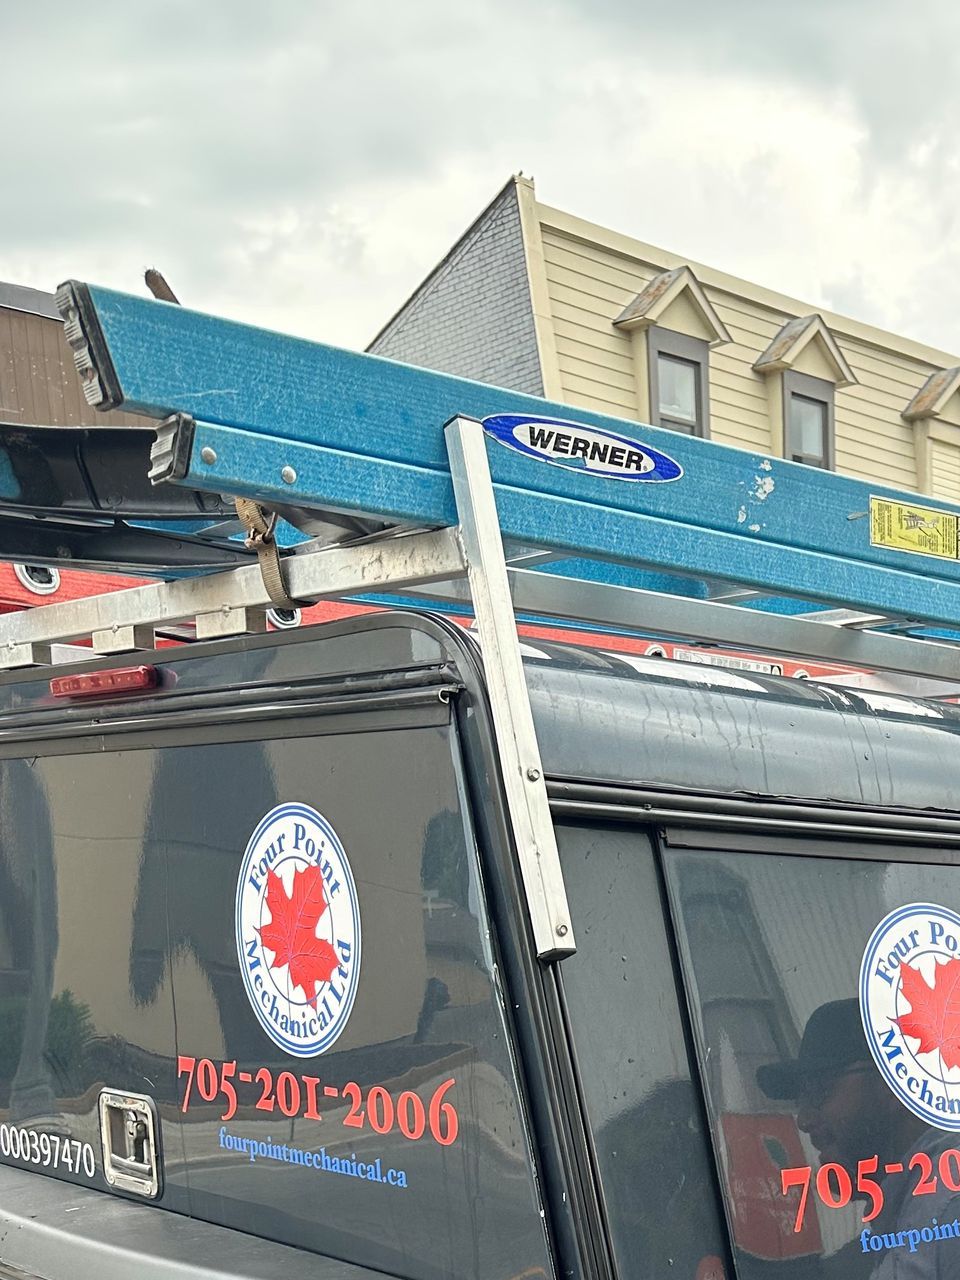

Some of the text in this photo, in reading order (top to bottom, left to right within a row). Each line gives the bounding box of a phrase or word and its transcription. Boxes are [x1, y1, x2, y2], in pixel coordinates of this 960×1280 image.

[529, 426, 644, 472] WERNER
[248, 823, 341, 899] Four Point
[245, 938, 351, 1038] Mechanical Ltd
[875, 929, 920, 988] Four
[178, 1055, 459, 1146] 705-201-2006
[0, 1124, 95, 1178] 000397470
[218, 1126, 408, 1188] fourpointmechanical.ca
